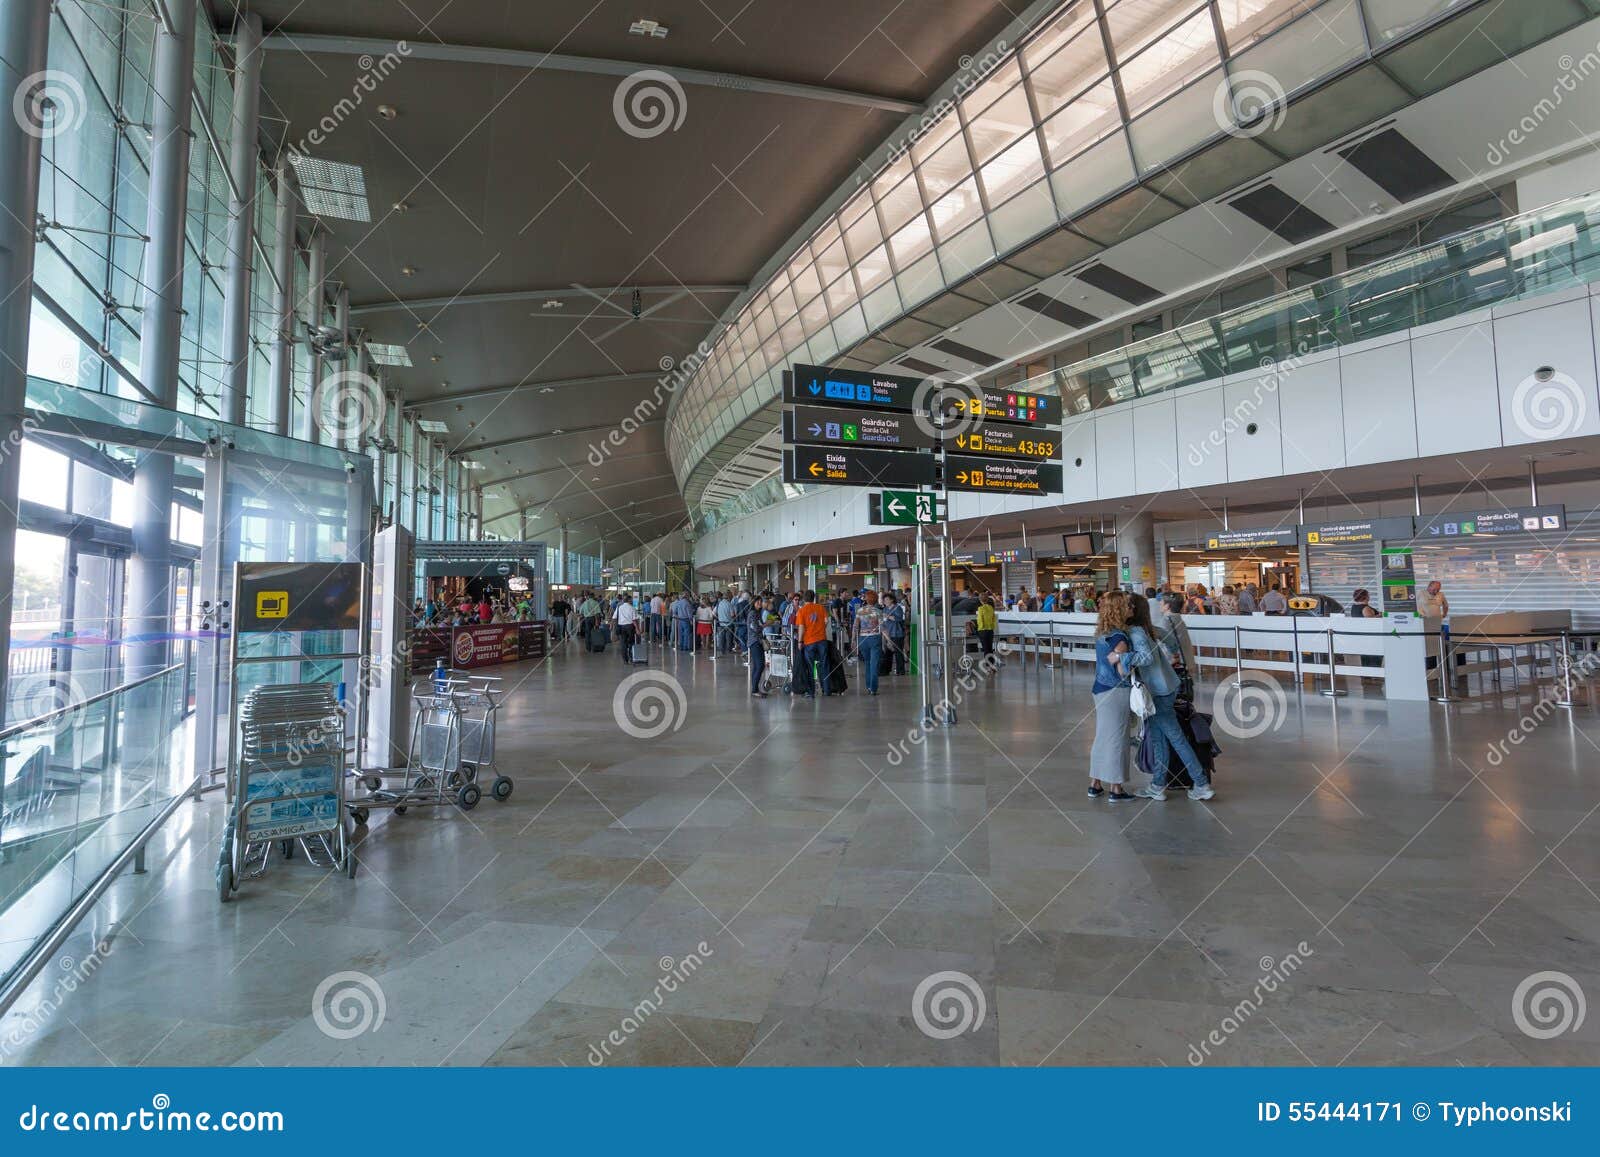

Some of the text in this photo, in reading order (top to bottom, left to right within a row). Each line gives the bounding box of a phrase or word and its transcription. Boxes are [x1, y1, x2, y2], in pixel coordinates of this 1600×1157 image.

[872, 378, 898, 390] Lavabos
[984, 393, 1002, 402] Portes
[984, 408, 1006, 417] Puertas
[886, 419, 899, 428] Civil
[886, 435, 900, 443] Civil
[826, 454, 846, 463] Eixida
[826, 462, 837, 470] Way
[985, 464, 1005, 473] Control
[826, 470, 847, 479] Salida
[985, 479, 1039, 490] Control de seguridad
[1477, 512, 1519, 521] Guàrdia Civil
[1504, 523, 1520, 531] Civil
[1321, 534, 1339, 542] Control
